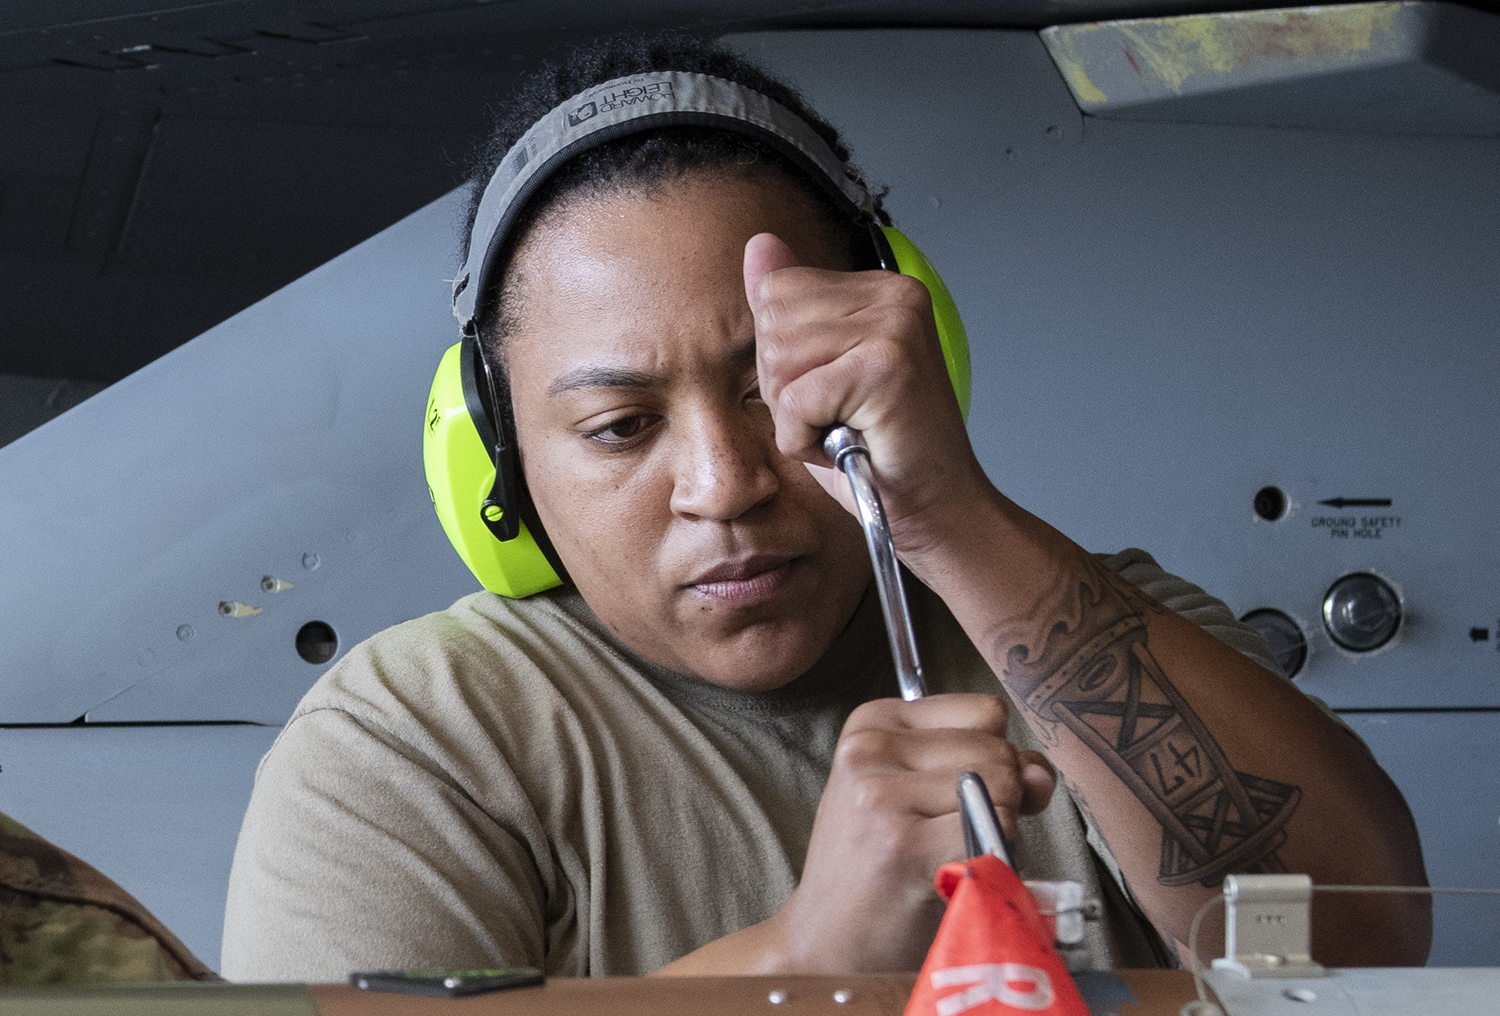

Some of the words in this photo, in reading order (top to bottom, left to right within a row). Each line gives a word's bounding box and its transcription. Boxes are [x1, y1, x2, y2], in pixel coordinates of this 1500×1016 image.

[603, 82, 673, 104] LEIGHT
[600, 92, 675, 113] HOWARD
[1311, 516, 1356, 528] GROUND
[1361, 516, 1402, 528] SAFETY
[1330, 528, 1349, 539] PIN
[1354, 528, 1382, 539] HOLE
